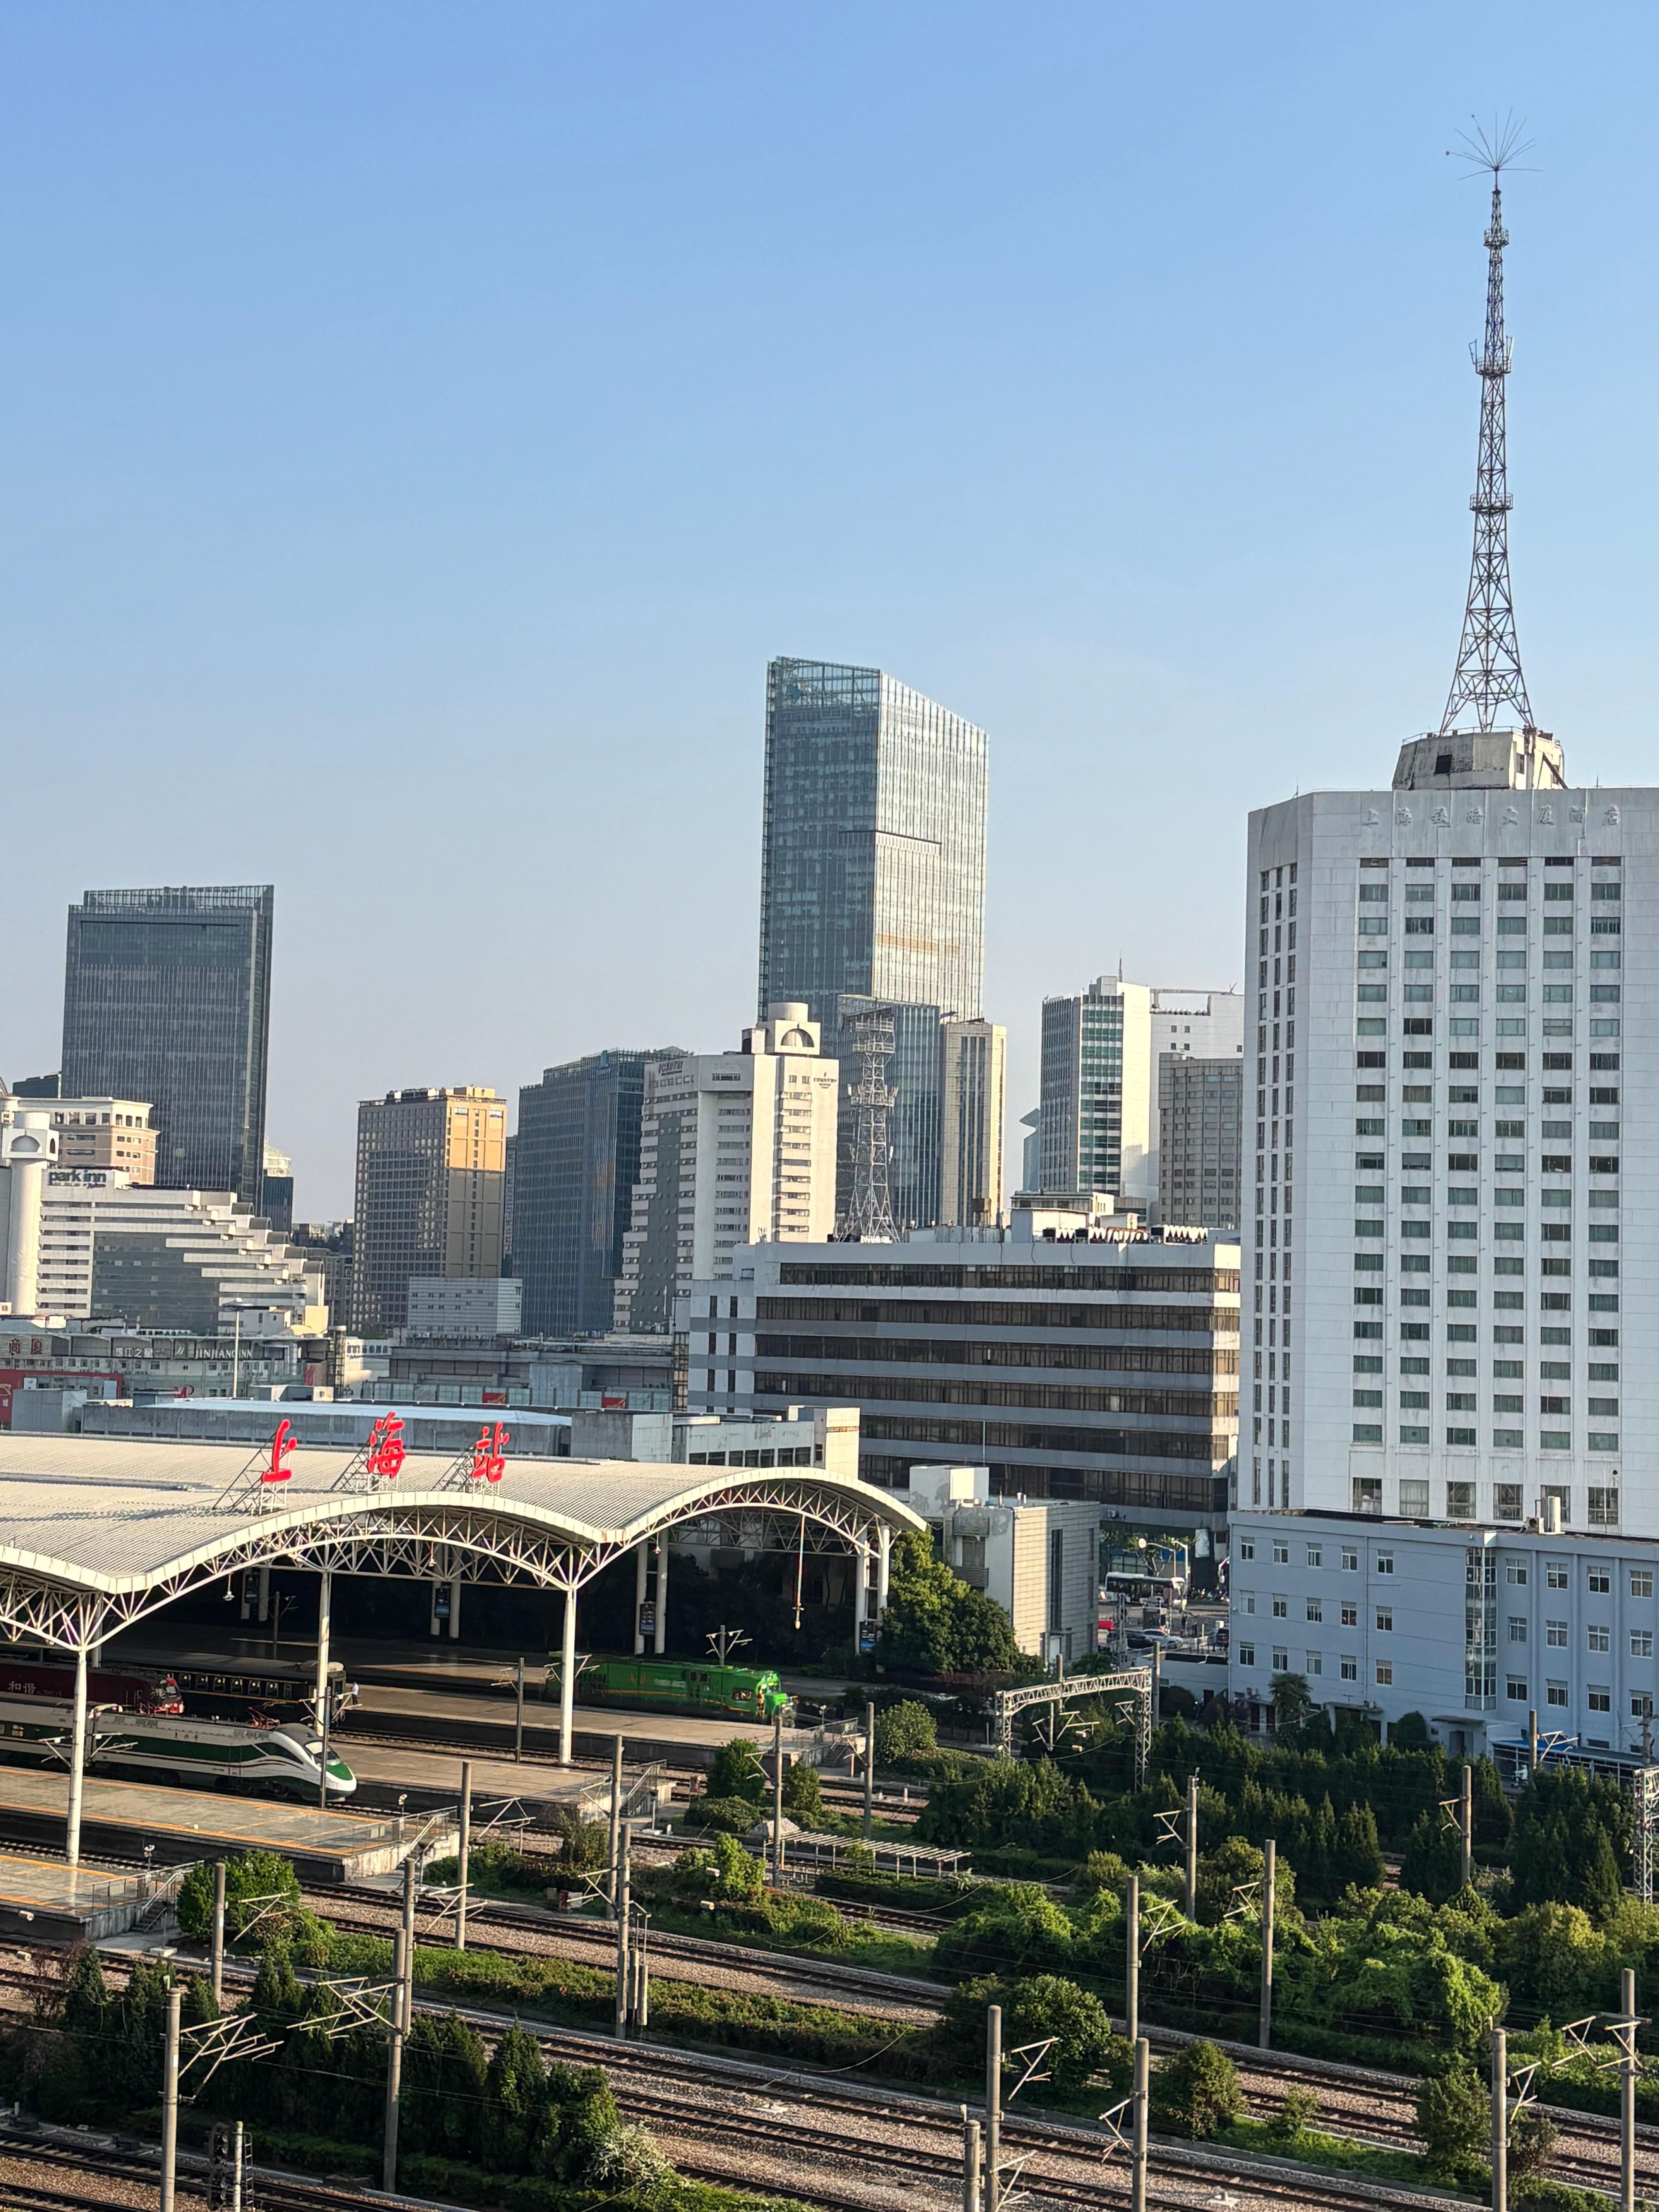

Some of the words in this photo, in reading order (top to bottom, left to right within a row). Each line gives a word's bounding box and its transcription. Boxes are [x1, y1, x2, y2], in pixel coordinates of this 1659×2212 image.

[49, 1170, 81, 1185] park
[262, 1411, 510, 1483] 上海站
[7, 1681, 36, 1694] 和谐
